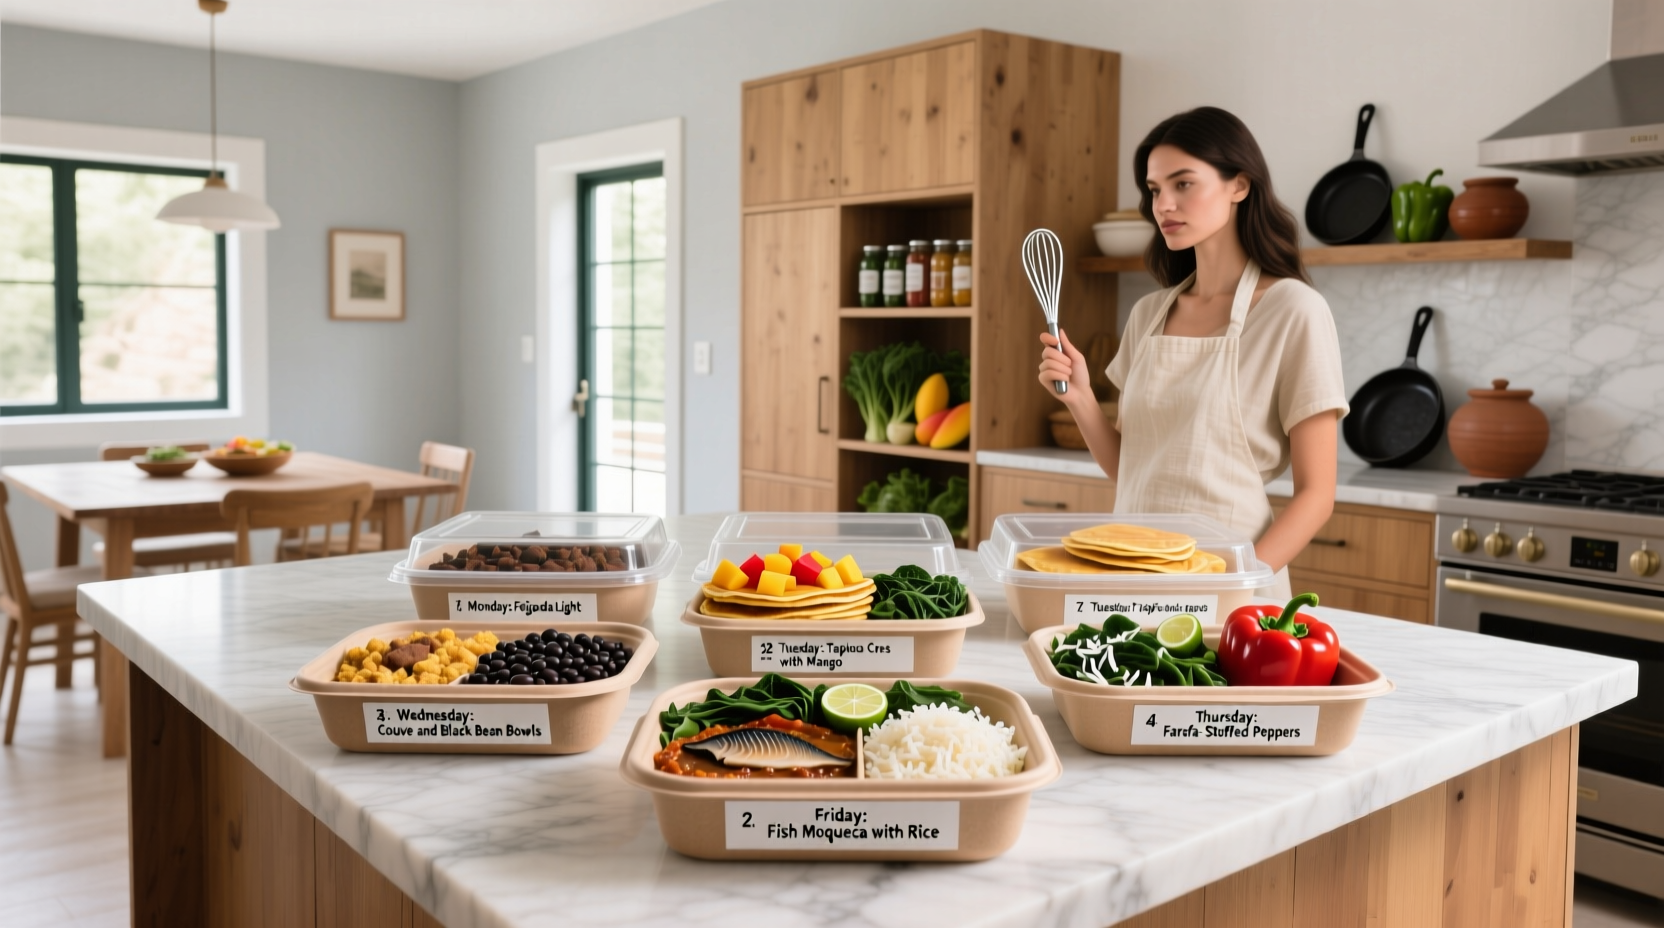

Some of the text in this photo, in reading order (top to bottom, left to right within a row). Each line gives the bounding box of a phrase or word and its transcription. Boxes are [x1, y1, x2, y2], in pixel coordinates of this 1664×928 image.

[467, 600, 513, 616] Monday:
[555, 600, 582, 615] Light
[806, 656, 843, 671] Mango
[397, 707, 475, 725] Wednesday:
[1195, 709, 1258, 726] Thursday:
[378, 724, 542, 737] Couve and Black Bean Bowls
[1253, 725, 1300, 741] Peppers
[742, 807, 868, 828] 2. Friday:
[767, 824, 940, 843] Fish Moqueca with Rice
